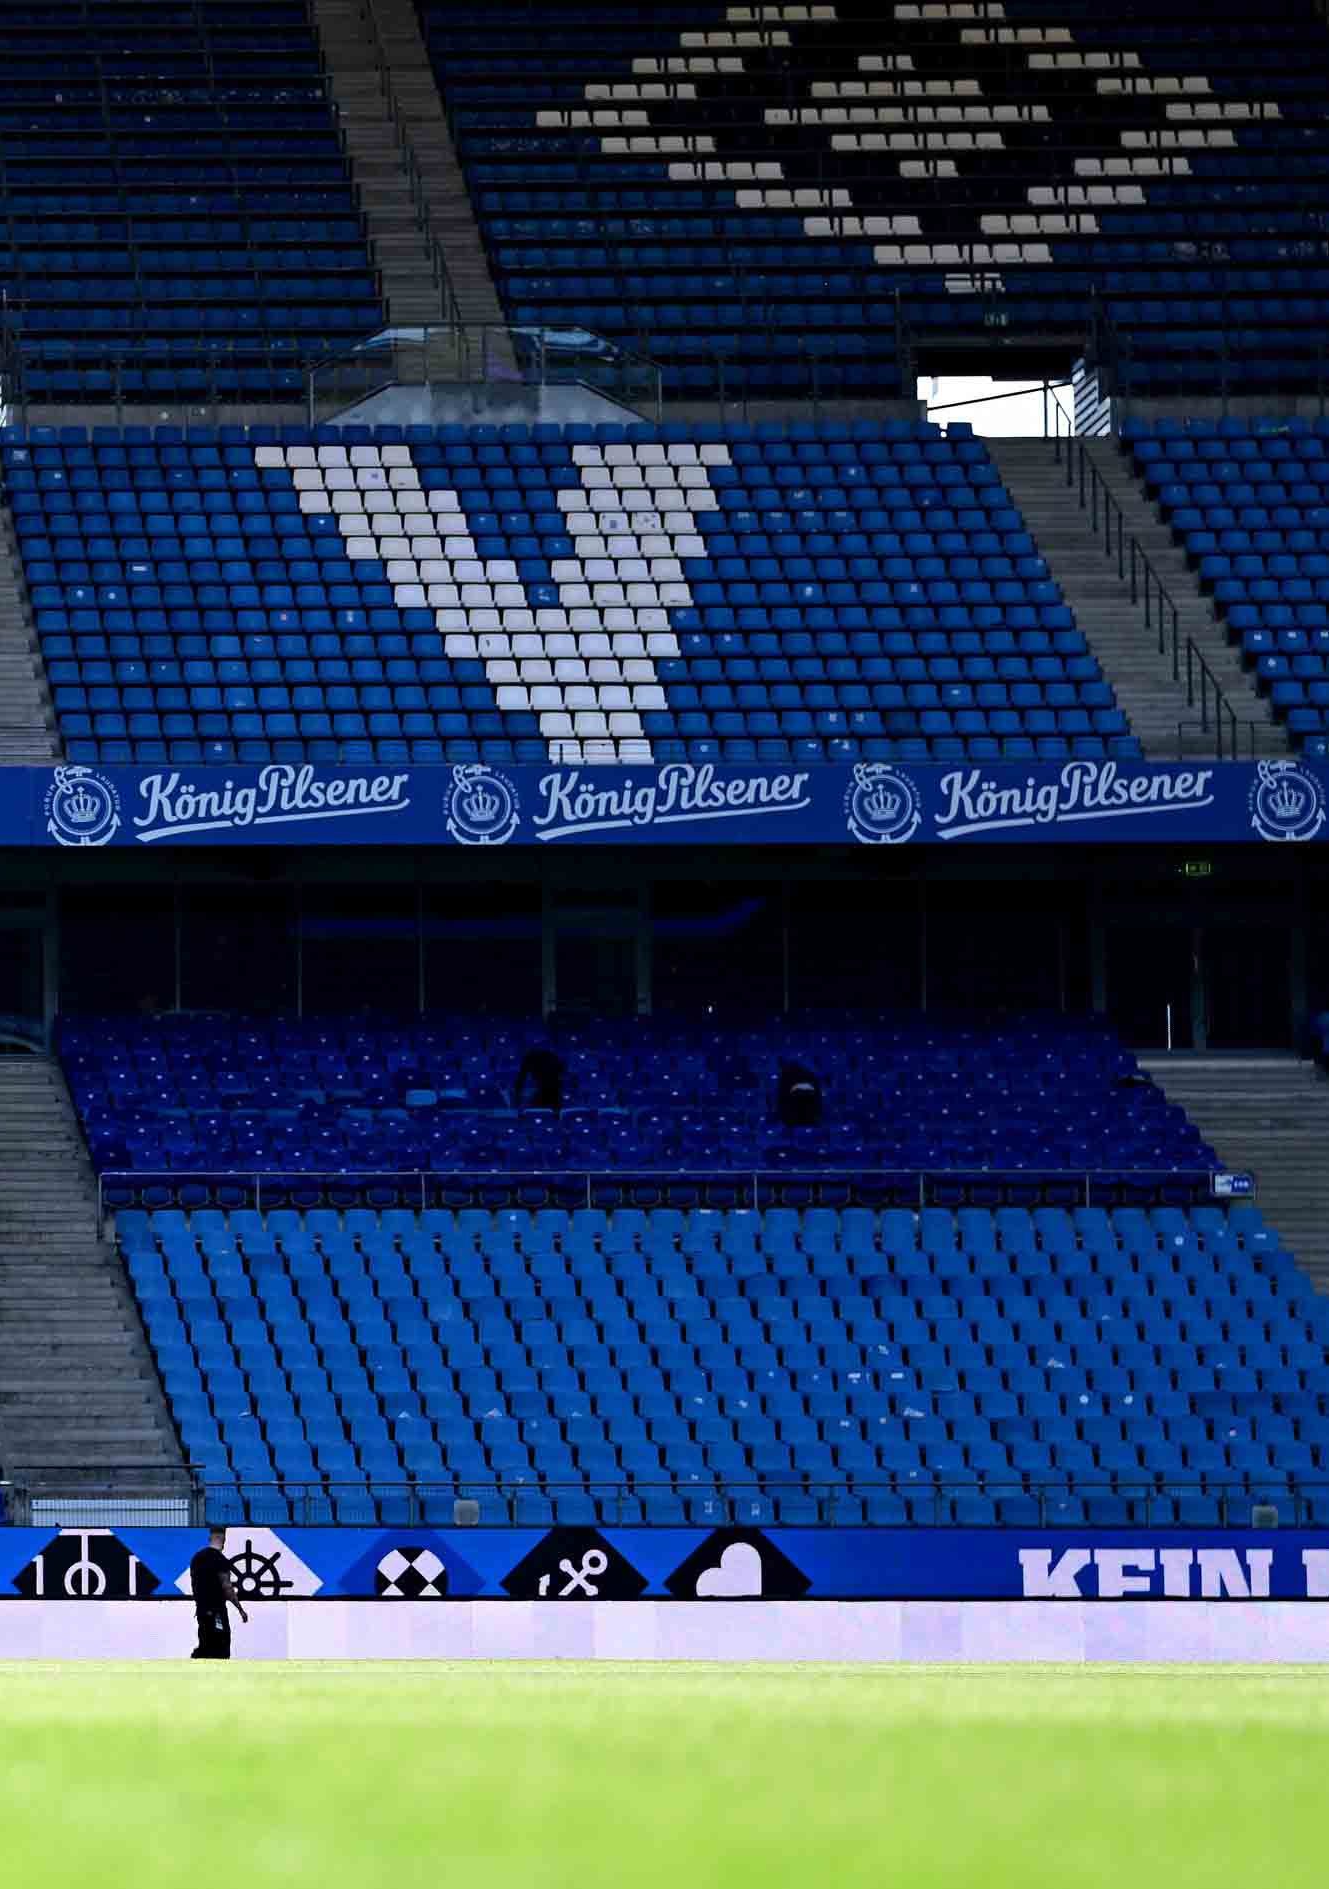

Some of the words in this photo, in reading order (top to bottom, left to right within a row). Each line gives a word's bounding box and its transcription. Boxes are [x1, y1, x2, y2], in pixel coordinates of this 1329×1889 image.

[133, 772, 257, 826] König
[256, 765, 410, 813] Pilsener
[532, 771, 657, 825] König
[656, 763, 810, 813] Pilsener
[934, 769, 1060, 823] König
[1059, 761, 1214, 810] Pilsener
[1018, 1548, 1274, 1598] KEIN
